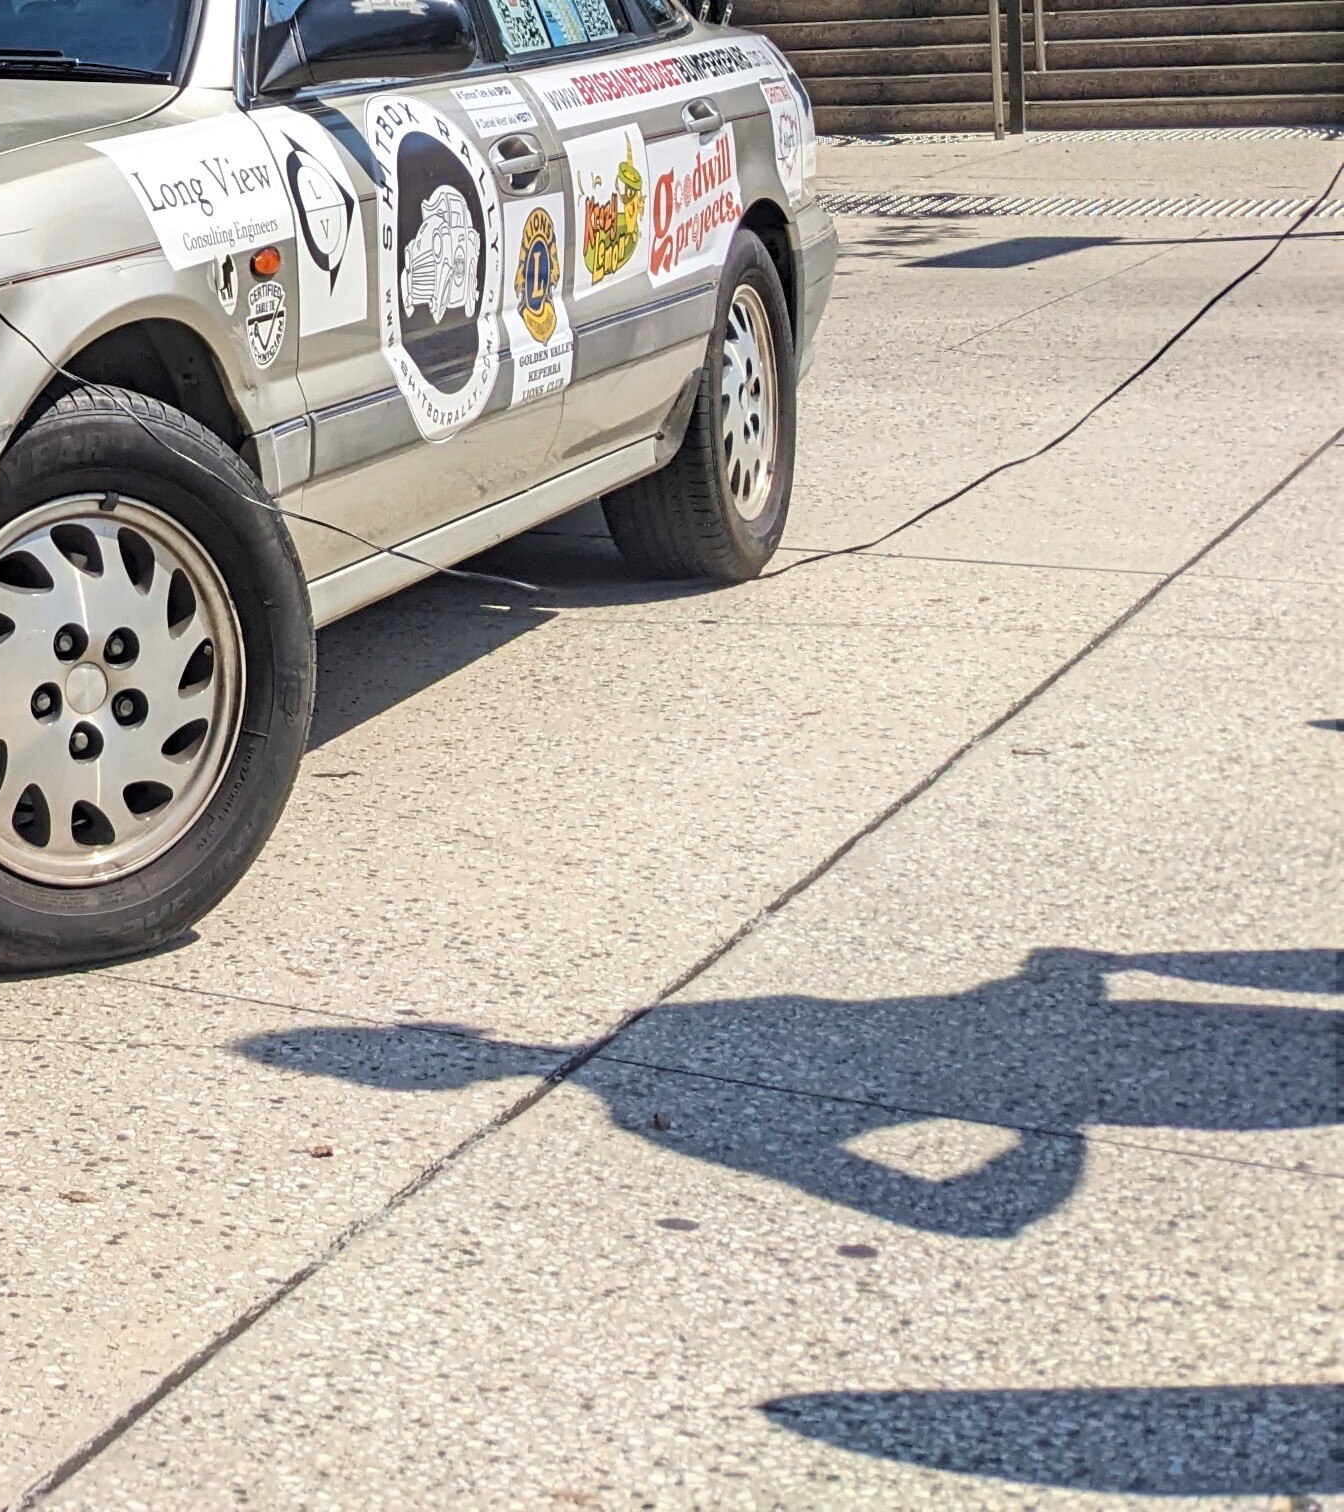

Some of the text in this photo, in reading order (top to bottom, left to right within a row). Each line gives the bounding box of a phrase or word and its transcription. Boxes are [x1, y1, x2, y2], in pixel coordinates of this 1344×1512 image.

[131, 157, 272, 217] Long View
[308, 179, 322, 200] L
[375, 102, 499, 254] SHITBOX RALLY
[182, 217, 279, 251] Consulting Engineers
[320, 218, 329, 239] V
[525, 213, 552, 244] LIONS
[531, 251, 546, 299] L
[249, 283, 283, 306] CERTIFIED
[519, 349, 548, 368] GOLDEN
[528, 361, 562, 383] KEPERRA
